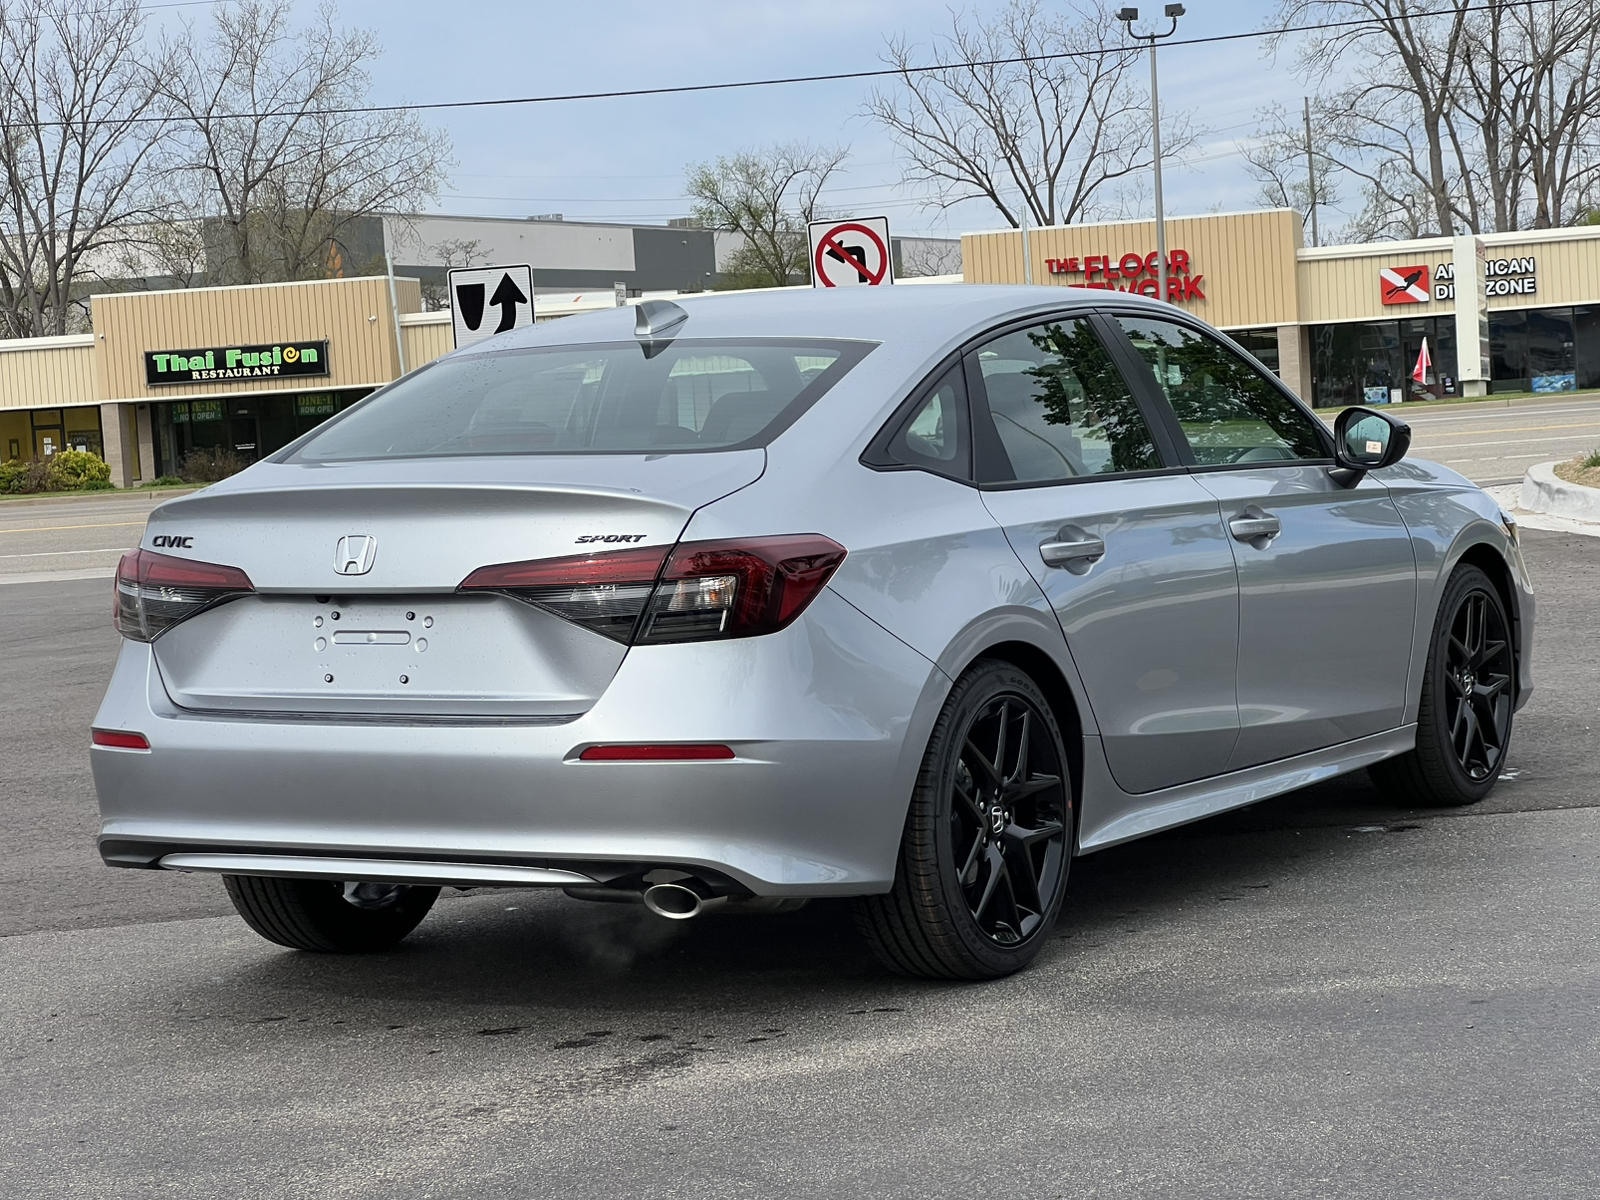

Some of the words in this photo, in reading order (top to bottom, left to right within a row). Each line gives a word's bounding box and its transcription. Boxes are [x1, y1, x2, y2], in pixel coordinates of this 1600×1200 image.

[1044, 257, 1080, 273] THE
[1083, 249, 1190, 281] FLOOR
[1485, 277, 1536, 297] ZONE
[152, 350, 215, 373] Thai
[225, 346, 319, 368] Fusion
[191, 366, 281, 380] RESTAURANT
[196, 411, 215, 420] OPEN
[300, 405, 316, 414] NOW
[152, 535, 194, 549] CIVIC
[574, 534, 648, 544] SPORT
